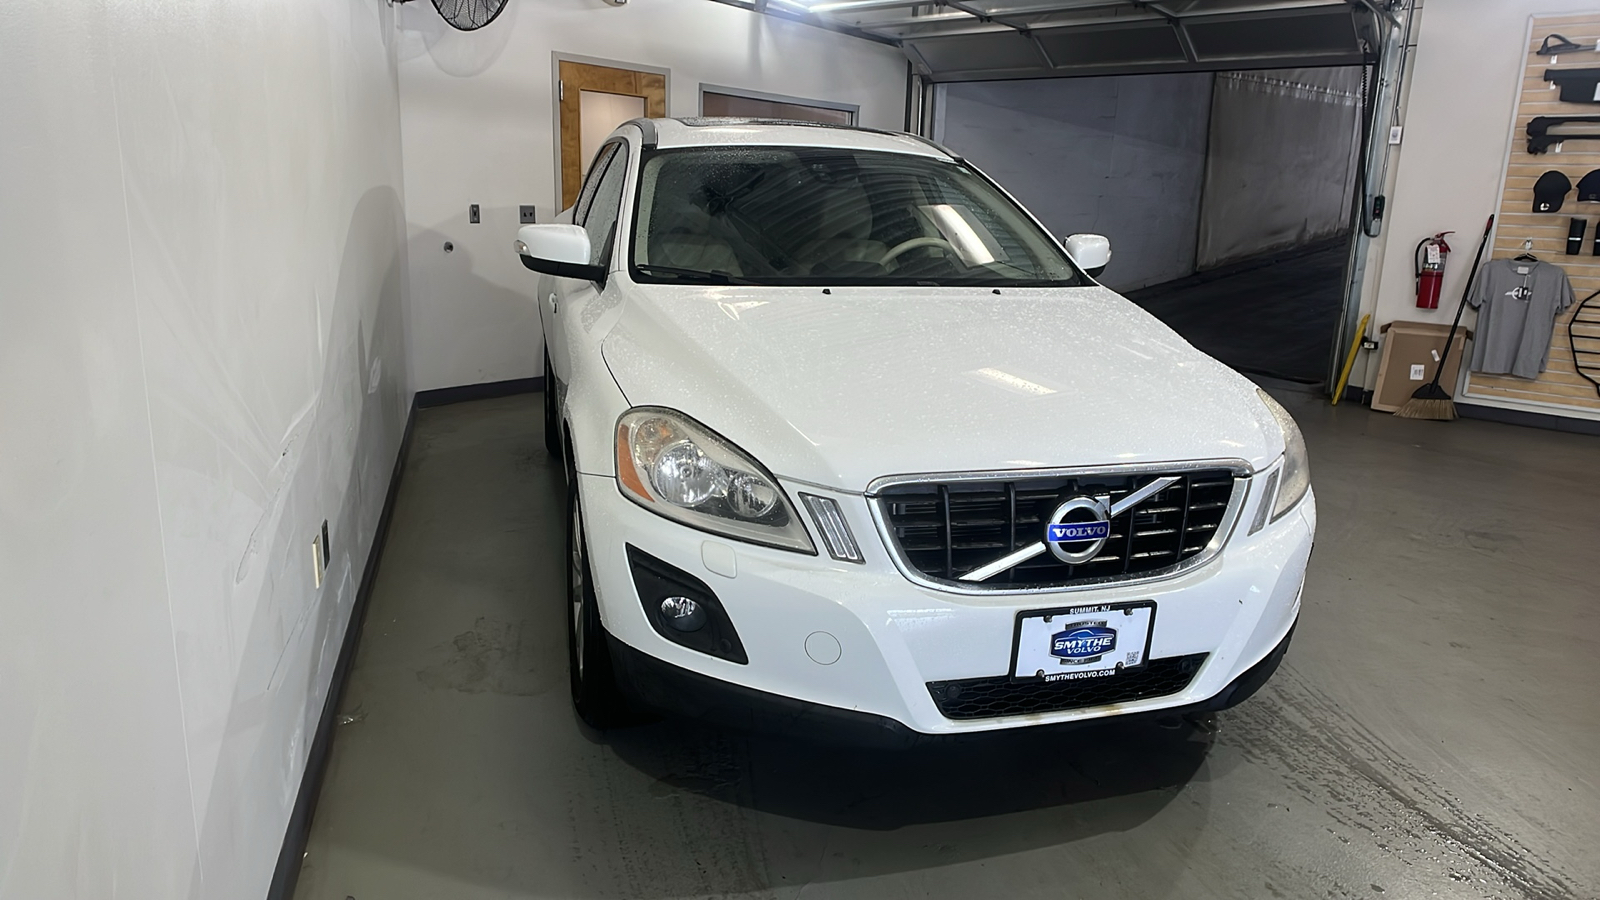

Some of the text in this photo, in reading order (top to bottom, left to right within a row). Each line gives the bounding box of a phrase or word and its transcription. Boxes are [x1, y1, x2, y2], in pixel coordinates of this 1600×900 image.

[1053, 526, 1106, 538] VOLVO
[1054, 637, 1113, 650] SMYTHE
[1067, 646, 1101, 654] VOLVO
[1045, 669, 1116, 682] SMYTHEVOLVO.COM
